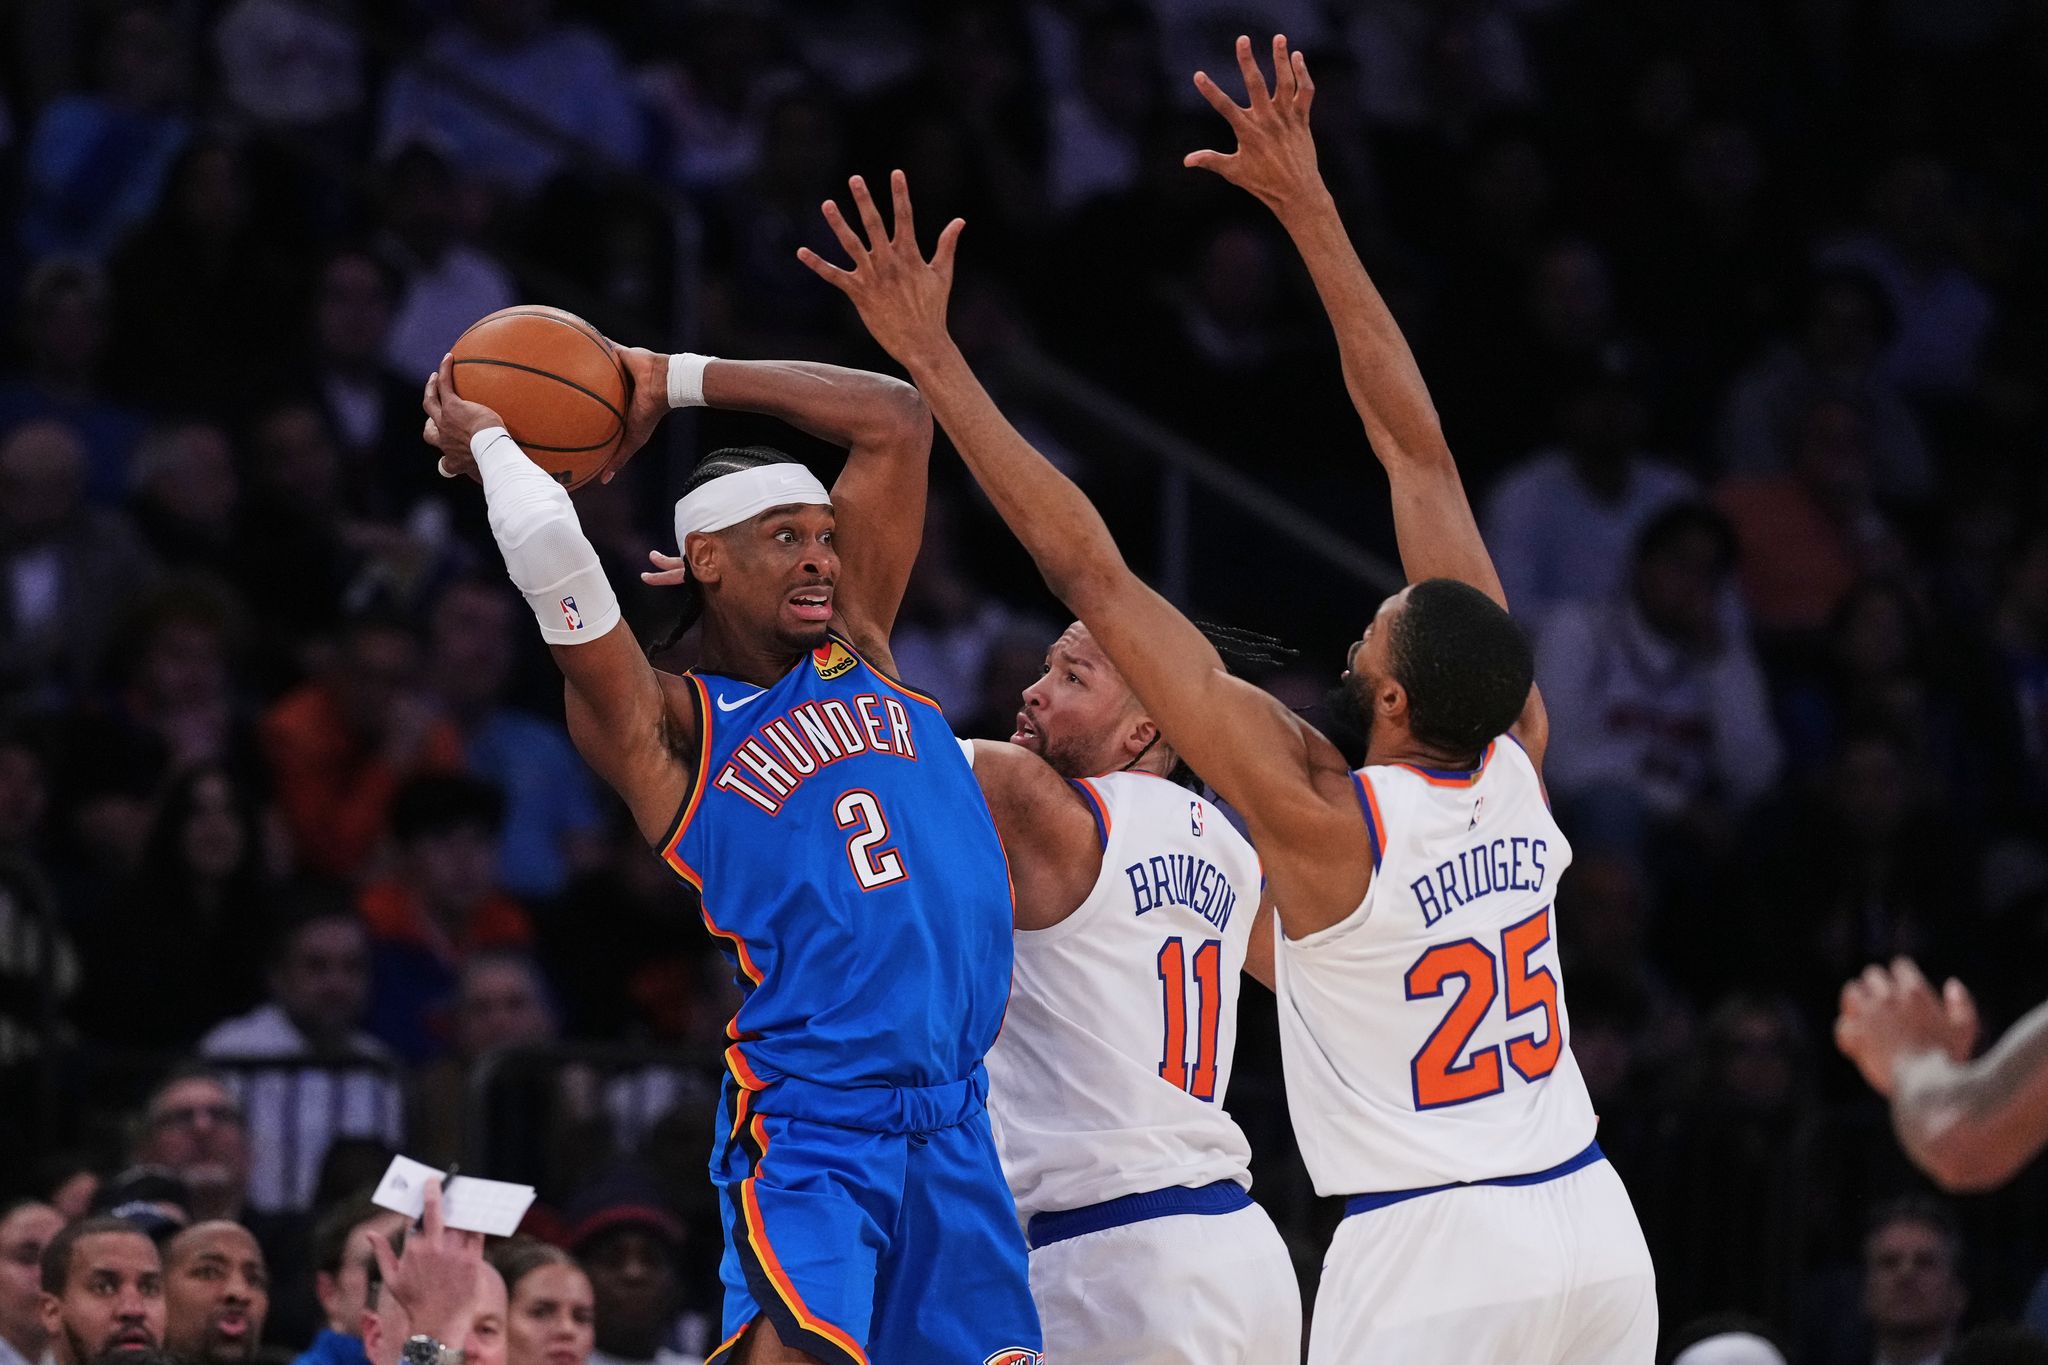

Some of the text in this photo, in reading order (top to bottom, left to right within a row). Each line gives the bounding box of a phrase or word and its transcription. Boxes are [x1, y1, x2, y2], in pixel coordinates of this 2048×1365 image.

[713, 693, 917, 817] THUNDER
[833, 788, 909, 892] 2
[1125, 854, 1236, 933] BRUNSON
[1410, 837, 1547, 928] BRIDGES
[1157, 936, 1221, 1103] 11
[1404, 903, 1563, 1112] 25
